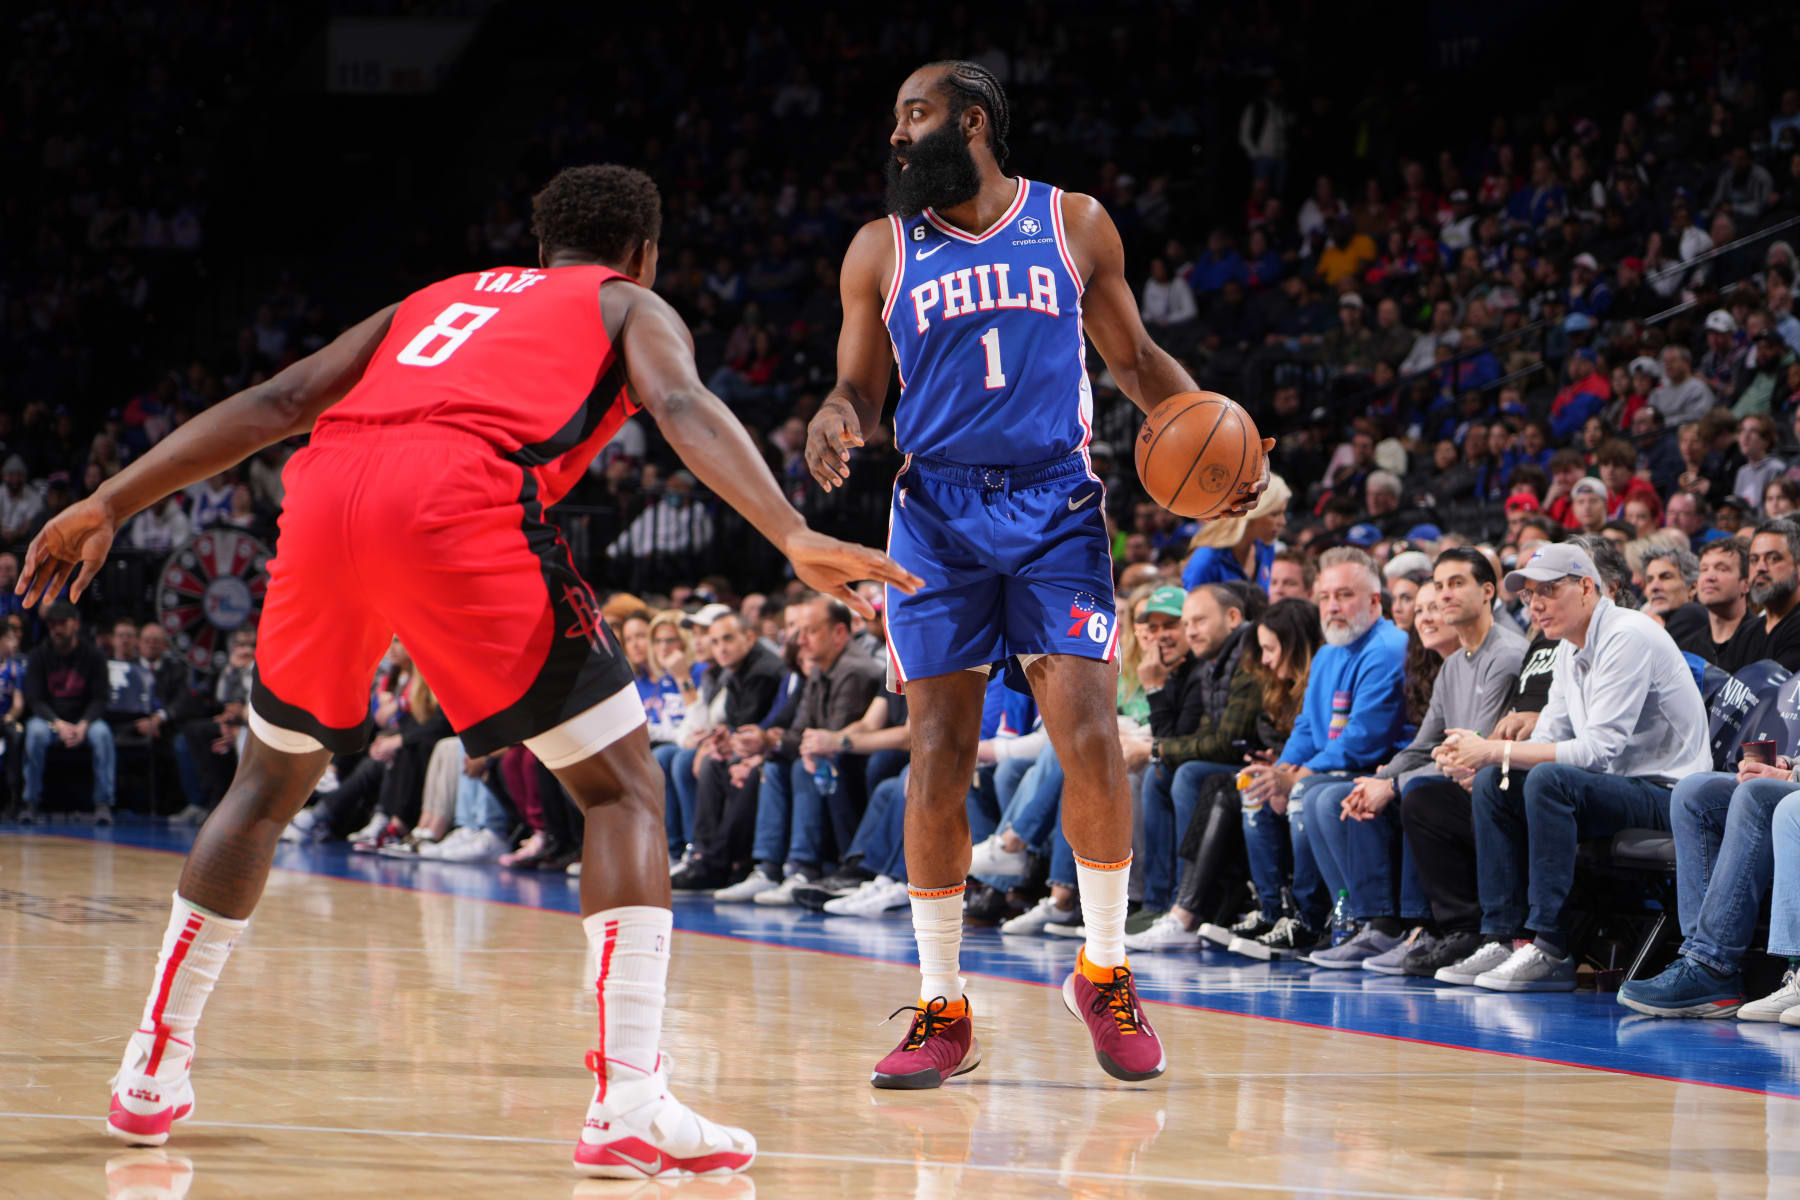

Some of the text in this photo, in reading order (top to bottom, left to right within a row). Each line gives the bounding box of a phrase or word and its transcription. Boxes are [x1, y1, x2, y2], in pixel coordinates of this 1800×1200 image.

[913, 226, 926, 241] 6
[1012, 237, 1054, 246] crypto.com
[910, 263, 1060, 336] PHILA
[397, 302, 500, 367] 8
[980, 327, 1006, 390] 1
[1067, 604, 1108, 643] 76
